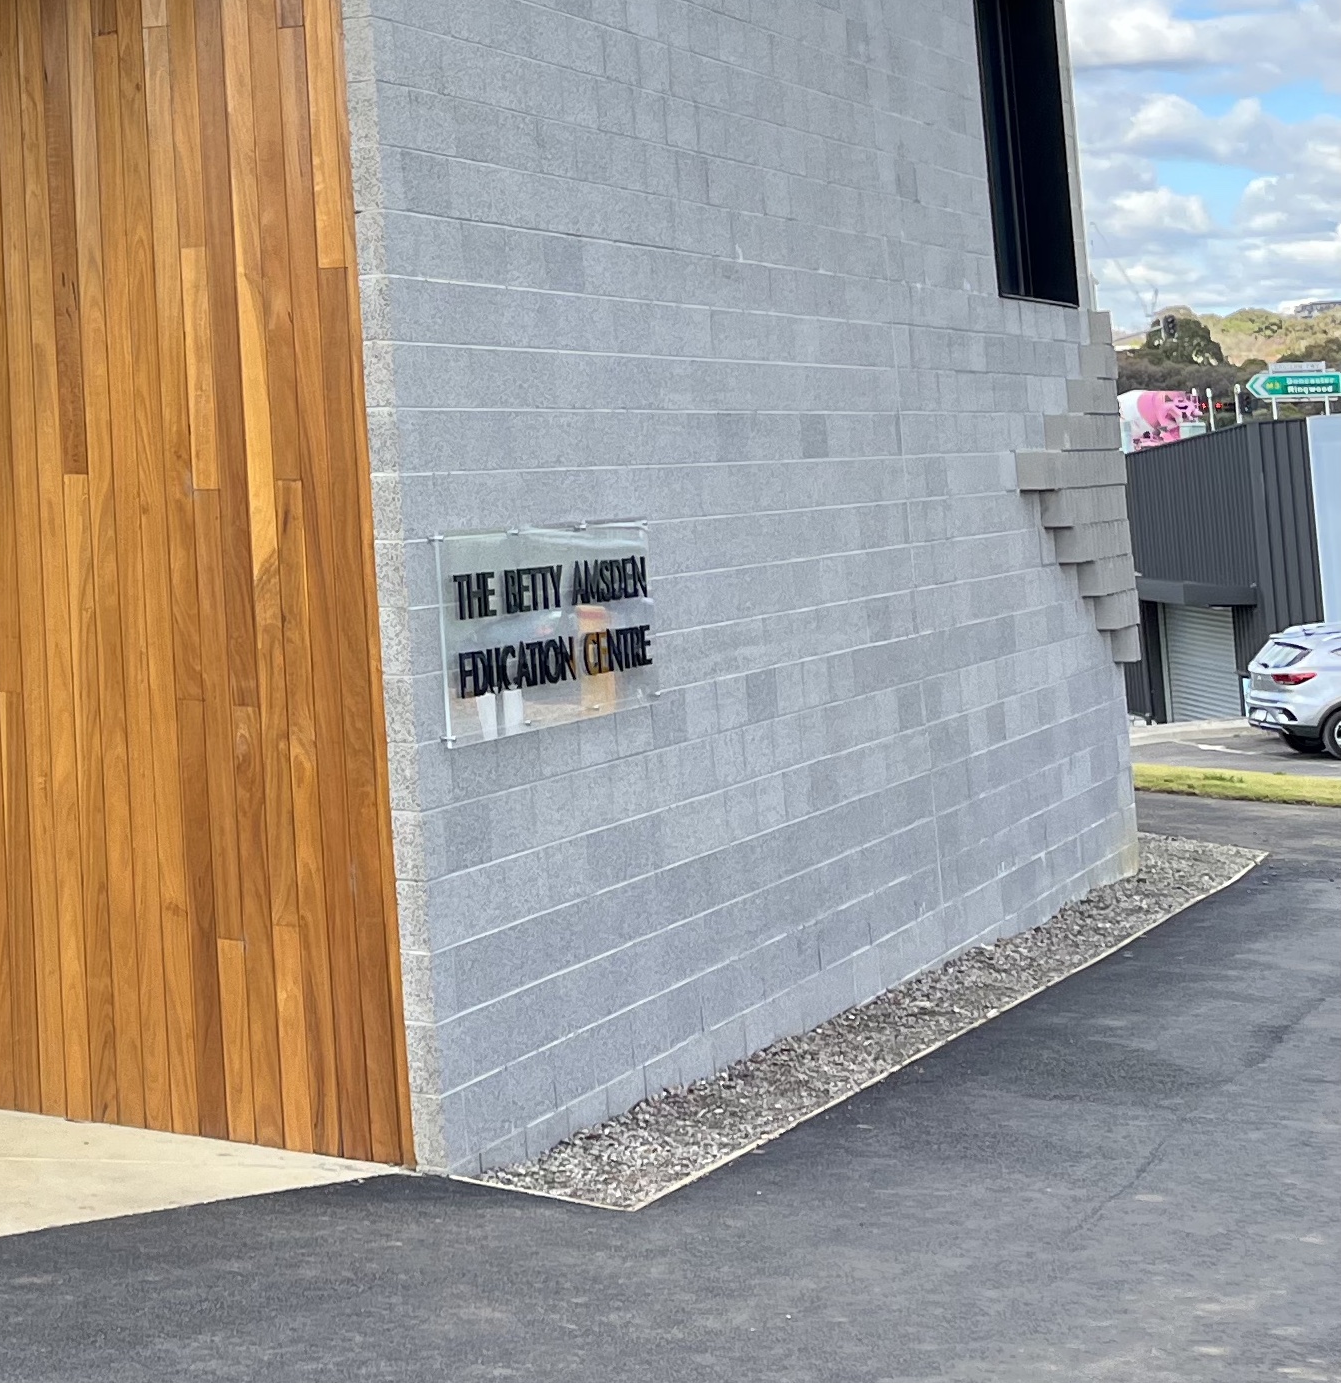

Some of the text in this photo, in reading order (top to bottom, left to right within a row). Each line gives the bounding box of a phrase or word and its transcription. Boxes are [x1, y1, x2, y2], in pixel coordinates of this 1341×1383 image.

[1287, 385, 1334, 394] Ringwood
[453, 555, 648, 620] THE BETTY AMSDEN
[458, 624, 653, 698] EDUCATION CENTRE
